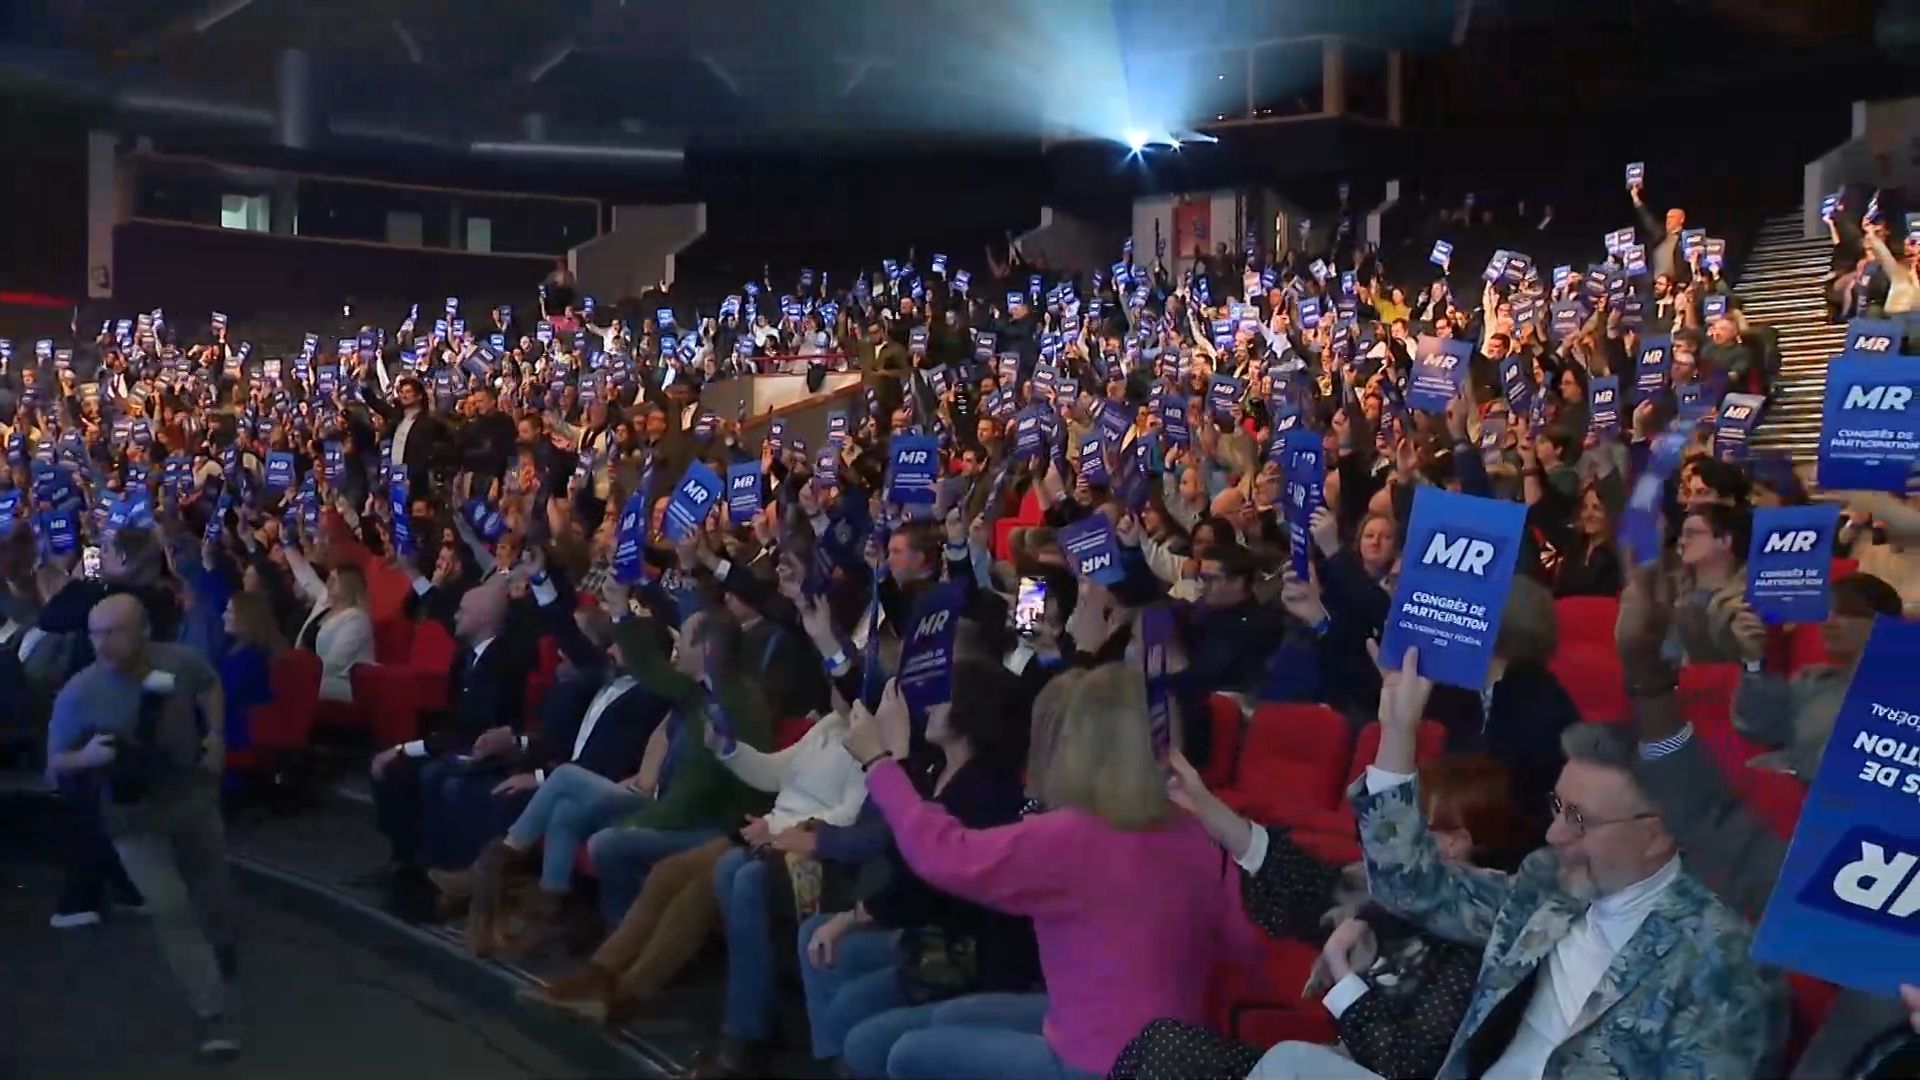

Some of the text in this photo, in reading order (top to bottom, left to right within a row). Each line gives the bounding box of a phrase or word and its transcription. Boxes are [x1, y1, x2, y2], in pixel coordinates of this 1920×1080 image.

[1854, 334, 1891, 352] MR
[1423, 352, 1457, 369] MR
[1642, 350, 1662, 364] MR
[1594, 390, 1613, 404] MR
[1843, 385, 1912, 410] MR
[1724, 405, 1751, 420] MR
[1830, 438, 1920, 450] PARTICIPATION
[1838, 428, 1915, 440] CONGRÈS DE
[898, 451, 927, 464] MR
[683, 479, 708, 504] MR
[734, 475, 754, 489] MR
[1764, 530, 1817, 553] MR
[1081, 552, 1111, 575] MR
[1422, 532, 1494, 576] MR
[1412, 591, 1486, 617] CONGRÈS DE
[917, 609, 950, 640] MR
[1402, 603, 1489, 632] PARTICIPATION
[1871, 703, 1920, 731] DÉRAL
[1859, 760, 1900, 788] DE
